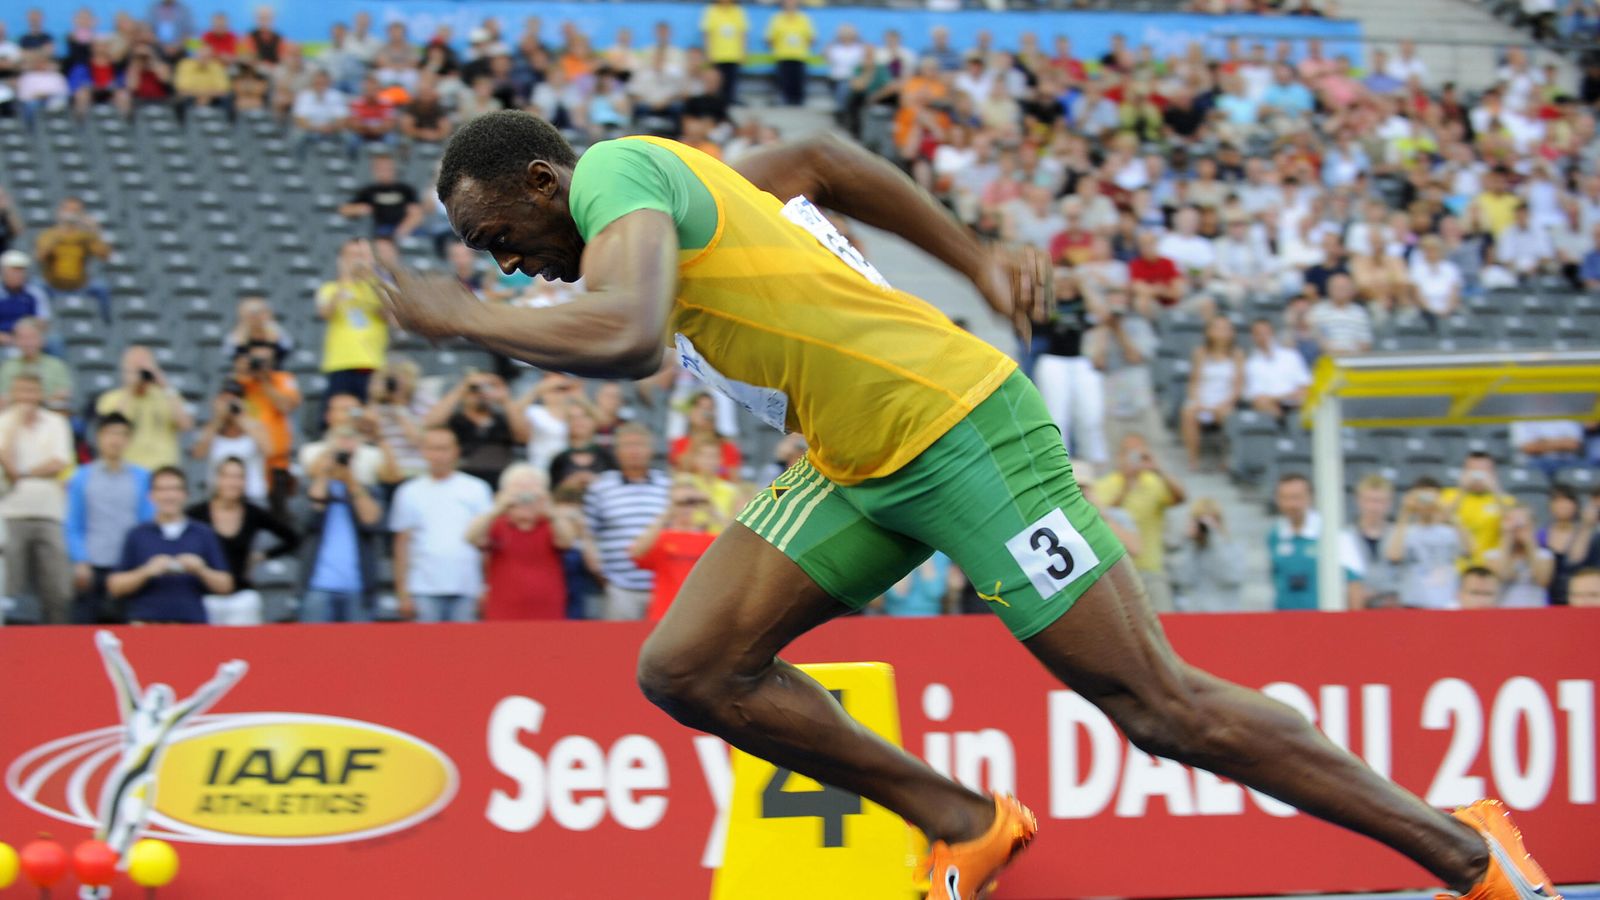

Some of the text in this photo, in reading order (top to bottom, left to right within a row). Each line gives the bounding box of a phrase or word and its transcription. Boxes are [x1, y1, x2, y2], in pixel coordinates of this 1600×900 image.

[1030, 527, 1075, 580] 3
[204, 747, 385, 786] IAAF
[486, 696, 669, 832] See
[922, 683, 1016, 798] in
[1048, 682, 1392, 819] DAU
[1420, 676, 1596, 811] 201
[760, 689, 863, 848] 4
[194, 792, 369, 815] ATHLETICS
